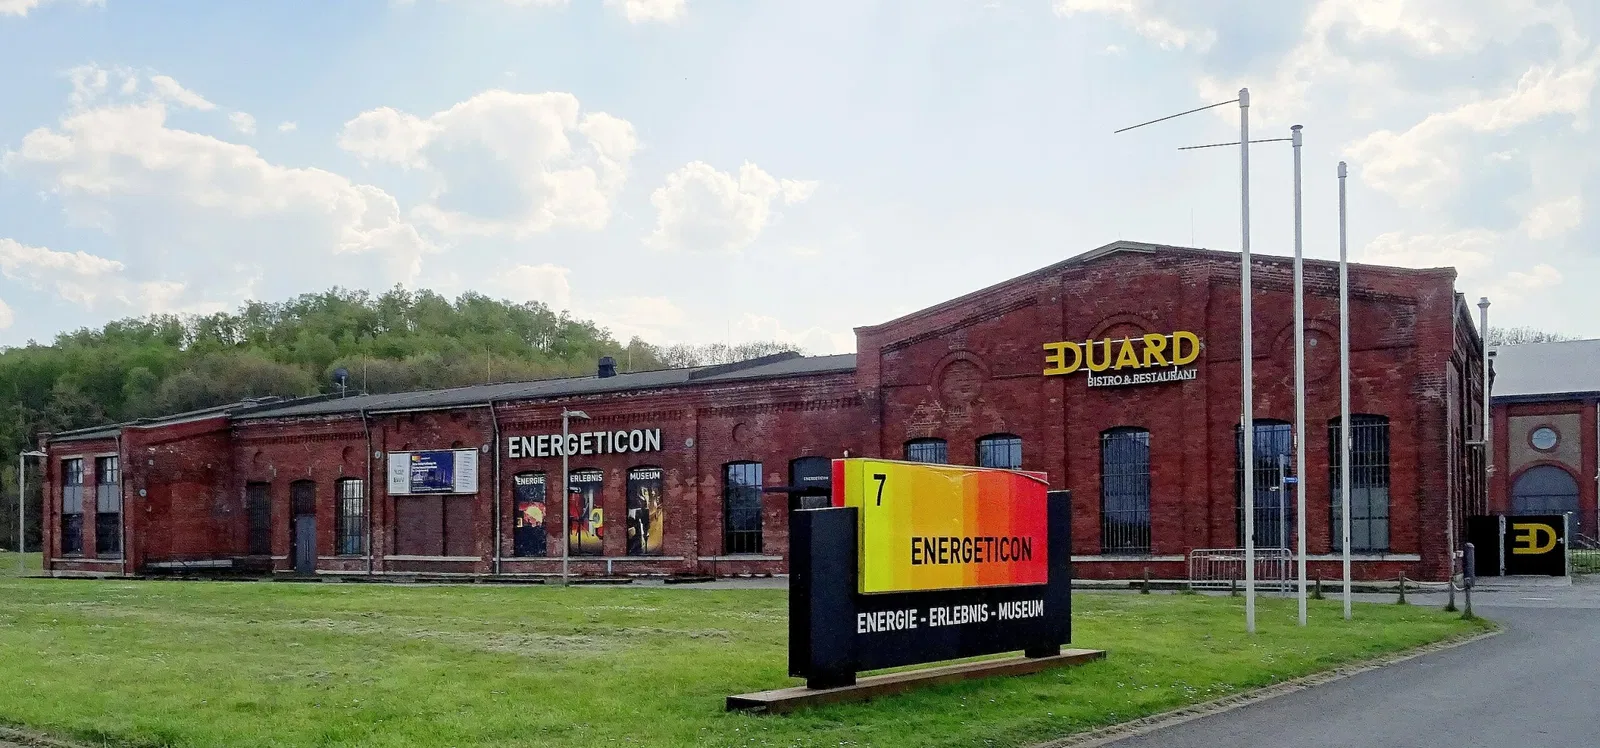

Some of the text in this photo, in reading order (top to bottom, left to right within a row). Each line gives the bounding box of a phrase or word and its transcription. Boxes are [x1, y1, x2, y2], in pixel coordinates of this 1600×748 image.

[1043, 331, 1200, 375] EDUARD
[1087, 369, 1197, 387] BISTRO & RESTAURANT
[508, 428, 661, 458] ENERGETICON
[516, 476, 544, 485] ENERGIE
[570, 473, 603, 482] ERLEBNIS
[629, 471, 661, 480] MUSEUM
[873, 474, 887, 506] 7
[911, 536, 1032, 565] ENERGETICON
[857, 609, 917, 634] ENERGIE
[929, 603, 988, 627] ERLEBNIS
[998, 600, 1044, 620] MUSEUM
